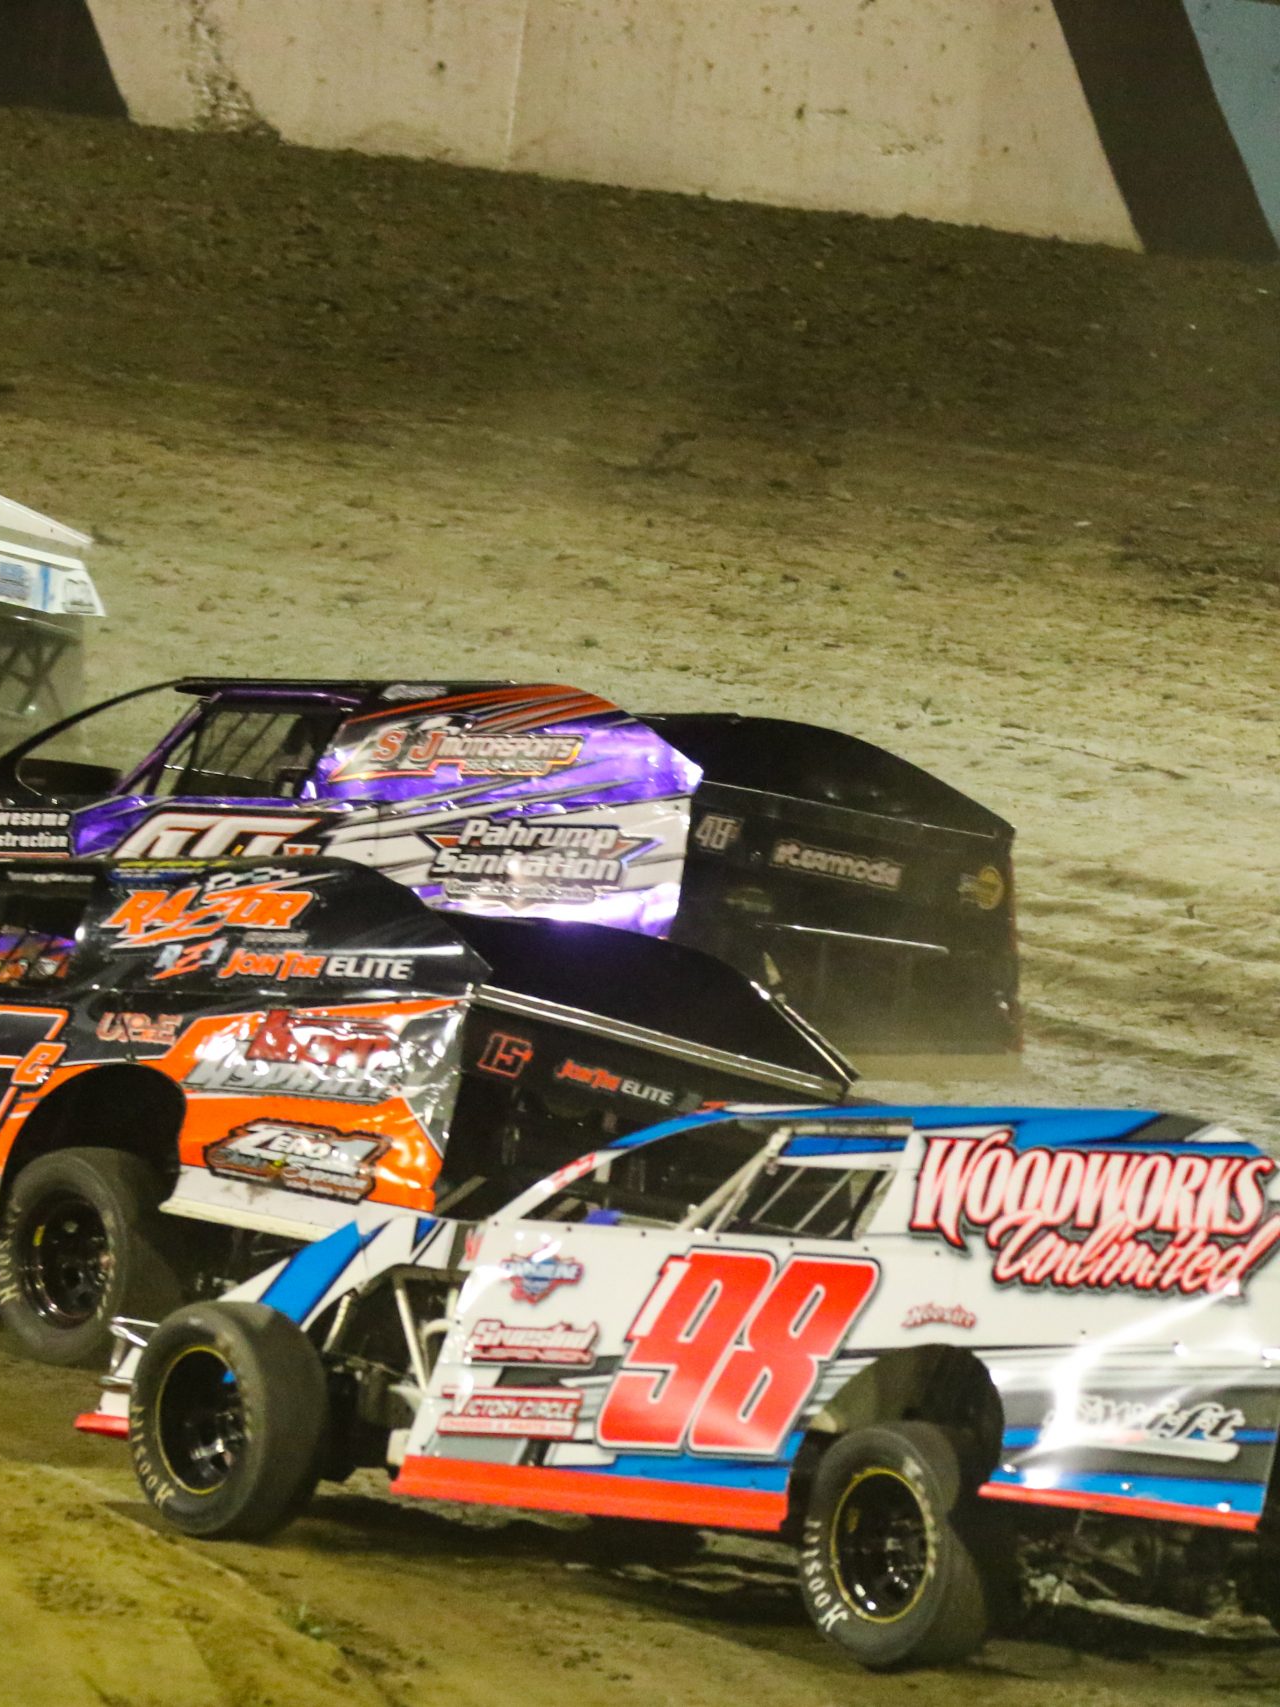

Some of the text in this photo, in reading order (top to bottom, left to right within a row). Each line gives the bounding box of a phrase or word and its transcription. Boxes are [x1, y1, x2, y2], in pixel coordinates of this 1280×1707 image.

[458, 818, 619, 857] Pahrump
[431, 846, 621, 882] Sanitation
[100, 874, 316, 949] RAZOR
[325, 955, 417, 980] ELITE
[620, 1078, 675, 1105] ELITE
[909, 1129, 1274, 1251] WOODWORKS
[985, 1209, 1280, 1296] Unlimited
[595, 1245, 882, 1460] 98
[451, 1391, 578, 1420] VICTORY CIRCLE
